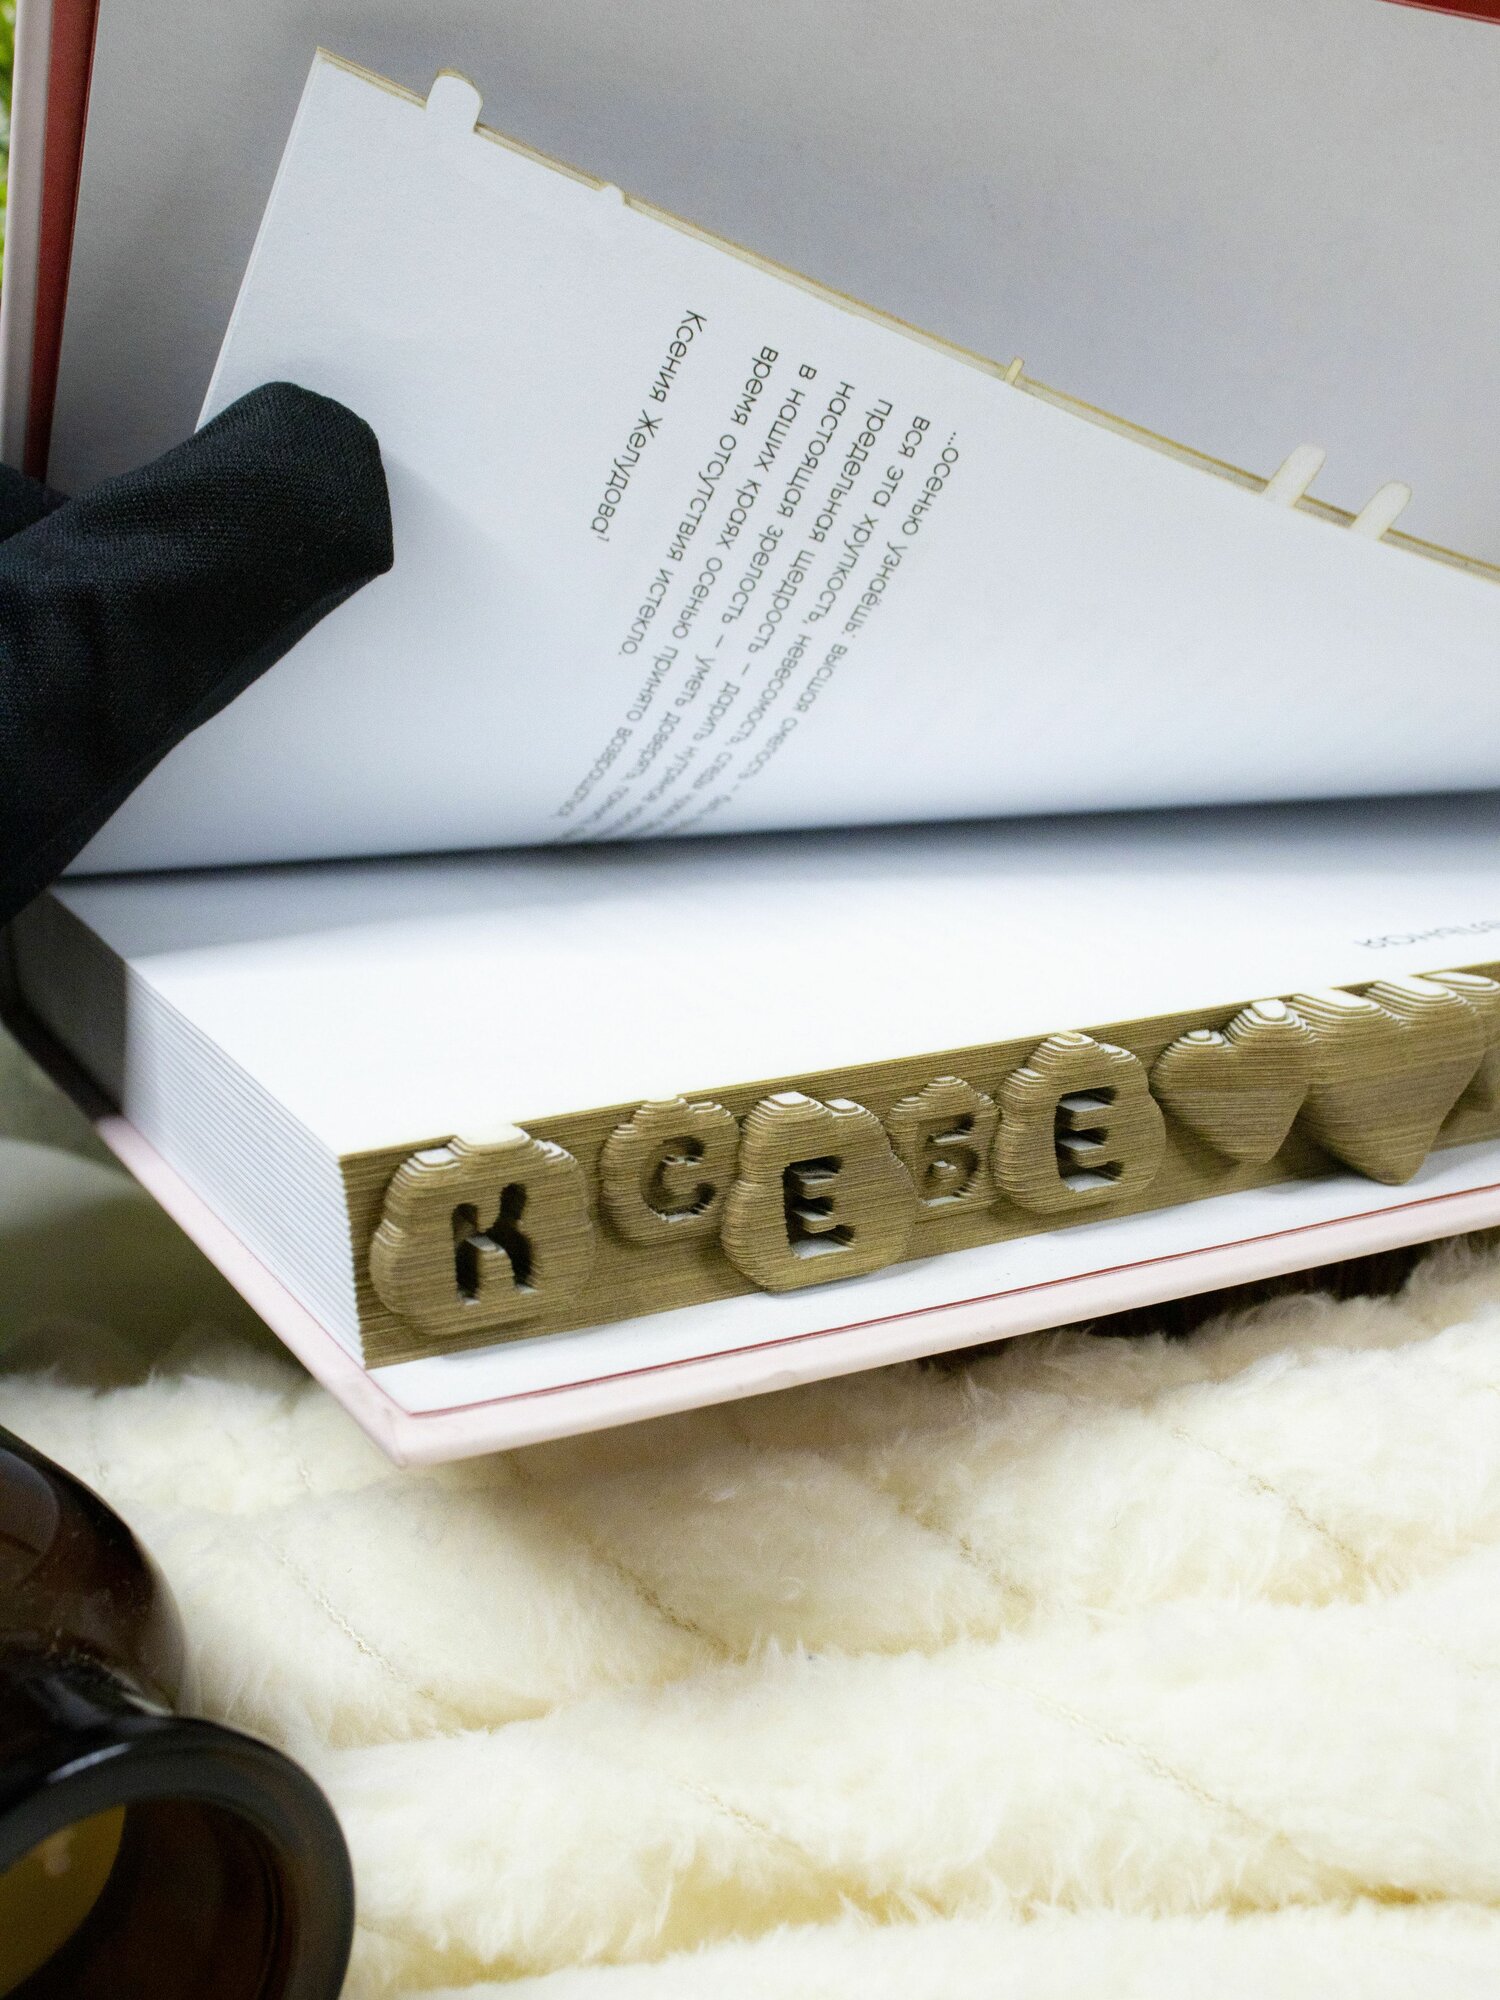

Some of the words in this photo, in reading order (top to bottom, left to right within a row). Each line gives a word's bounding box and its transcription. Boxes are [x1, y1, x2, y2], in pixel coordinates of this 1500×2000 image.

[649, 310, 707, 403] Ксения
[731, 346, 779, 426] время
[799, 364, 817, 380] в
[754, 388, 805, 472] наших
[777, 381, 855, 518] настоящая
[809, 399, 893, 543] предельная
[898, 416, 930, 458] вся
[667, 434, 737, 562] отсутствия
[716, 479, 762, 550] краях
[872, 465, 904, 508] эта
[672, 557, 723, 639] осенью
[721, 525, 784, 624] зрелость
[748, 550, 815, 653] щедрость
[802, 513, 879, 624] хрупкость,
[841, 541, 908, 638] узнаёшь:
[618, 568, 674, 655] истекло.
[626, 646, 679, 722] принято
[674, 655, 715, 707] уметь
[693, 681, 740, 741] дарить
[794, 643, 848, 713] высшая
